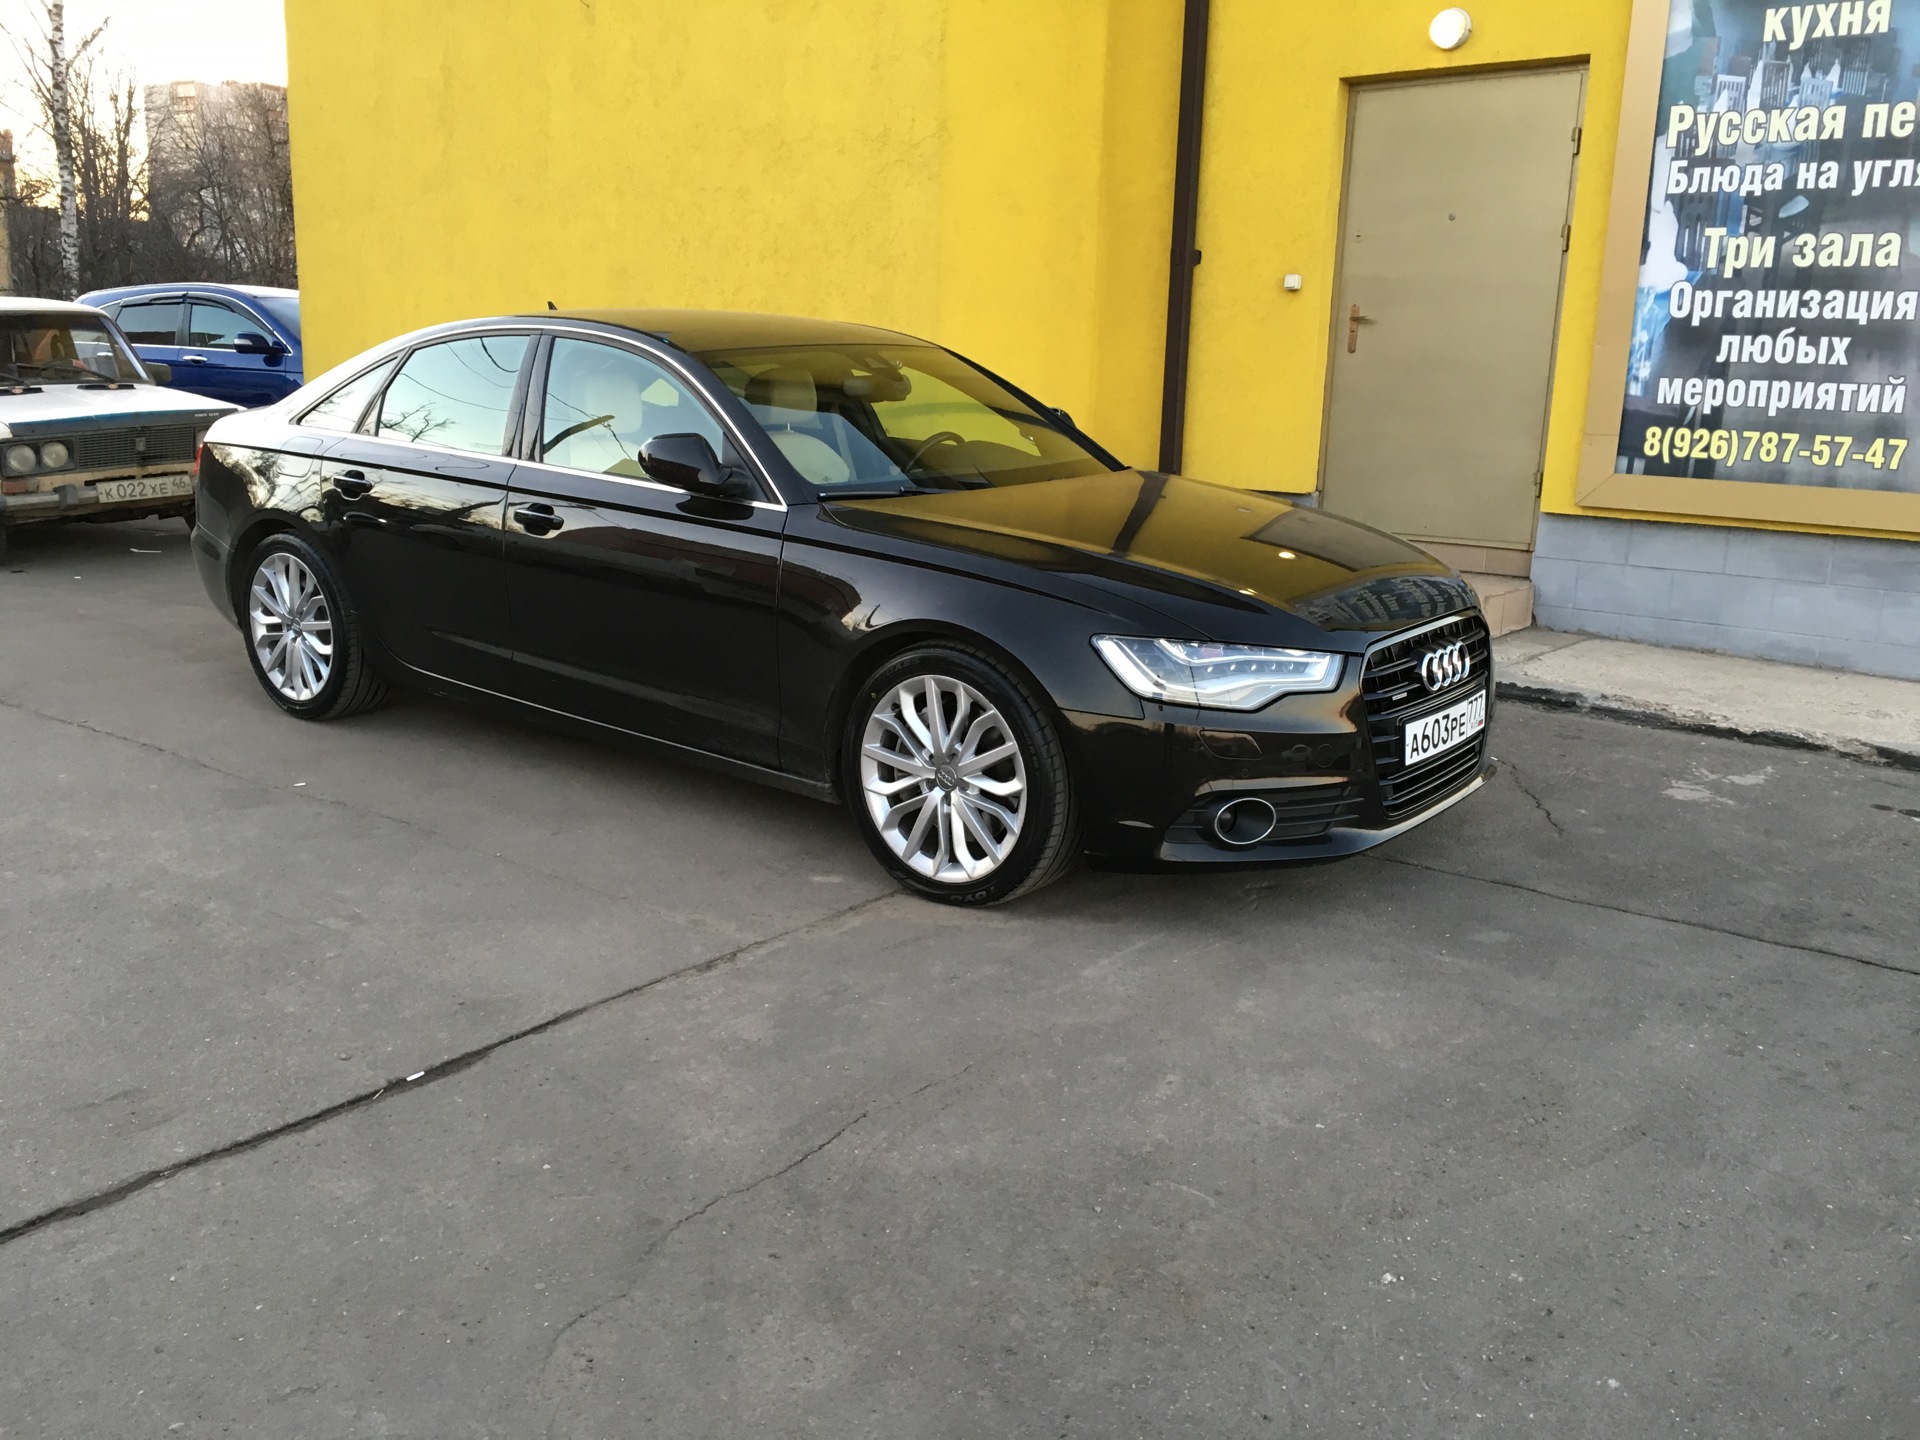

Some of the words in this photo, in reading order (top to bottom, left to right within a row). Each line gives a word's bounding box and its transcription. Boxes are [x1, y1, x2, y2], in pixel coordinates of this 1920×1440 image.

[1763, 0, 1892, 50] кухня
[1666, 103, 1847, 156] Русская
[1862, 101, 1917, 138] пе
[1667, 159, 1785, 197] Блюда
[1796, 160, 1839, 190] на
[1704, 227, 1776, 278] Три
[1792, 232, 1902, 268] зала
[1669, 280, 1919, 326] Организация
[1716, 327, 1852, 366] любых
[1656, 376, 1907, 417] мероприятий
[1643, 426, 1909, 471] 8(926)787-57-47
